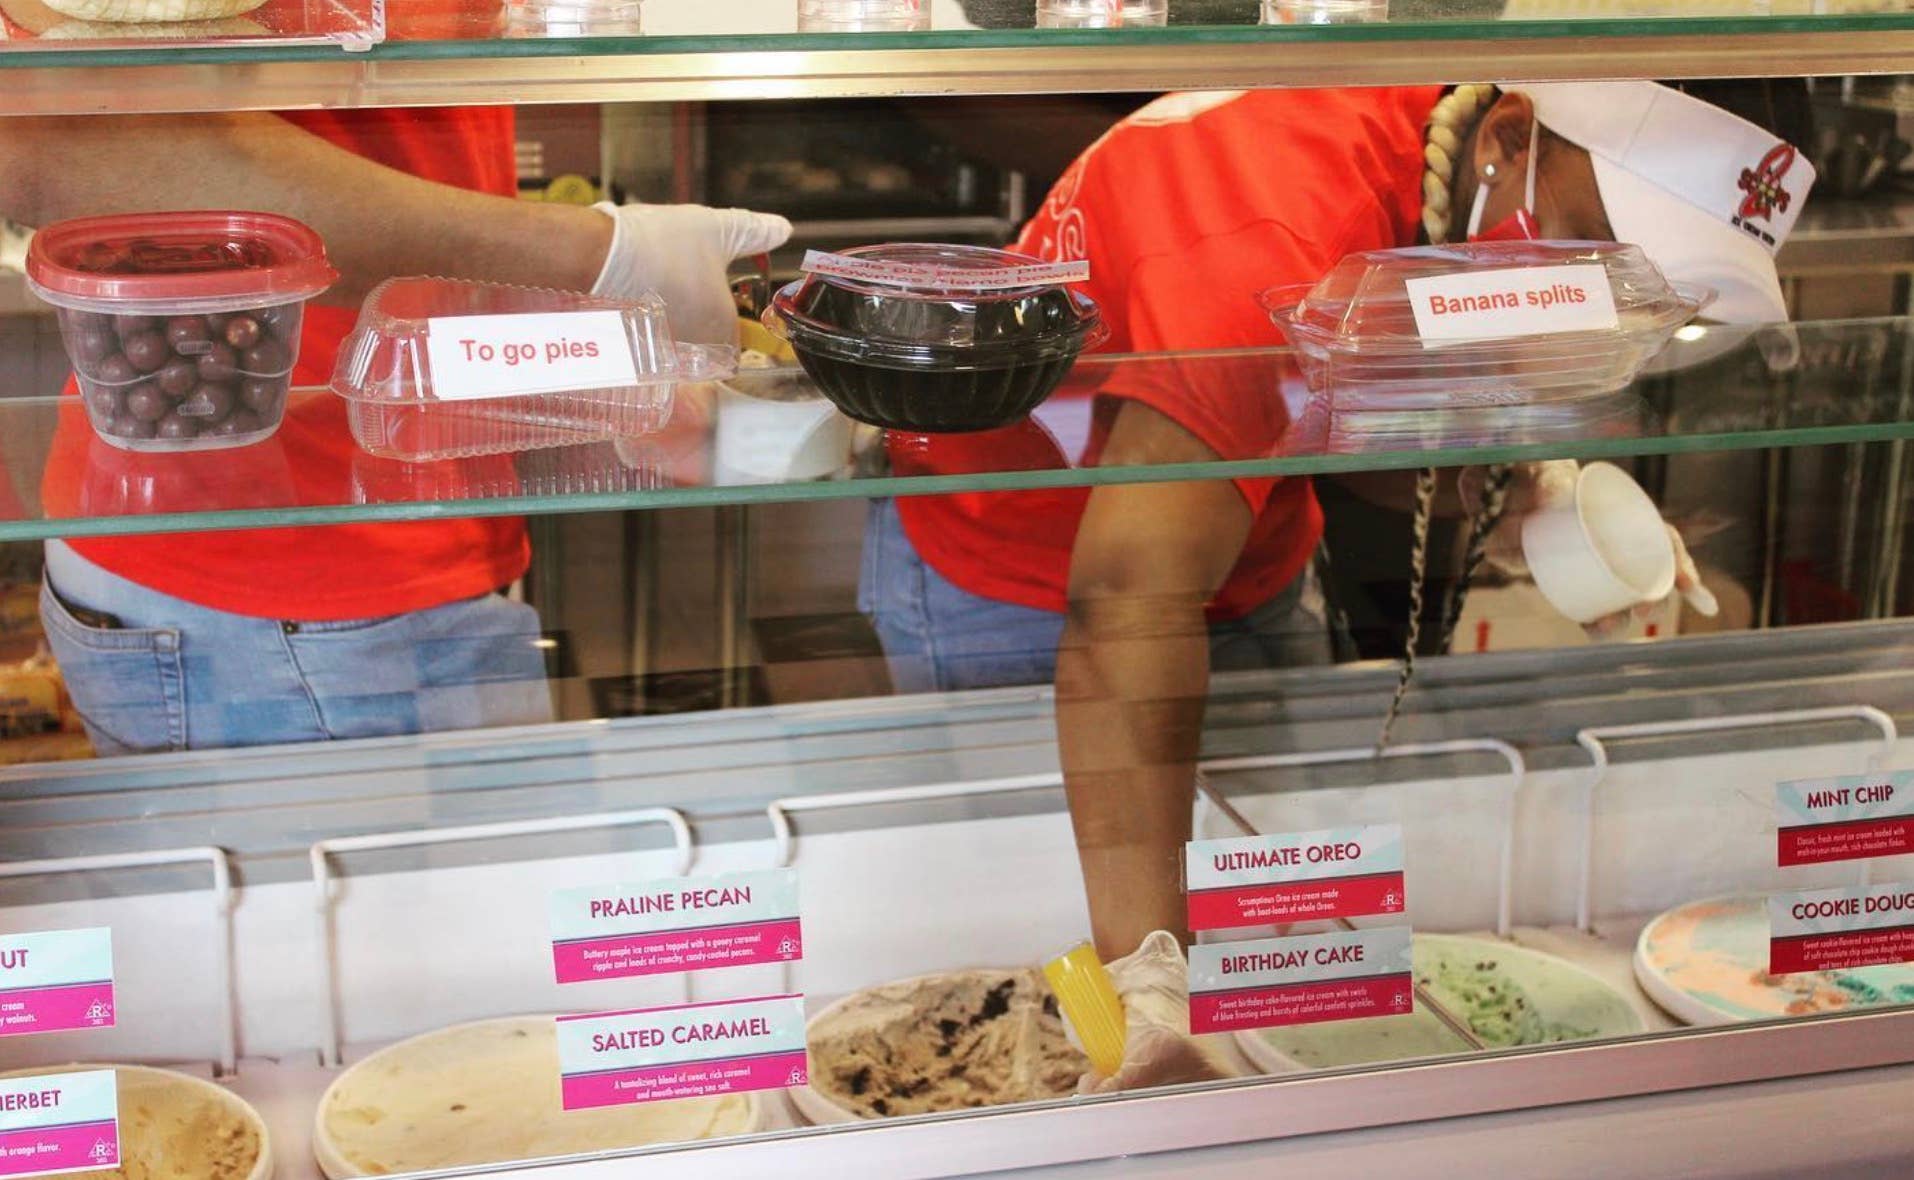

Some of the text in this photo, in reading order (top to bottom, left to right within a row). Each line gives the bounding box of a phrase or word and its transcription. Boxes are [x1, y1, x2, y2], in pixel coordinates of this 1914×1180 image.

[1429, 284, 1586, 315] Banana splits
[459, 337, 599, 366] To go pies
[1807, 785, 1894, 809] MINT CHIP
[1214, 842, 1361, 871] ULTIMATE OREO
[590, 886, 752, 919] PRALINE PECAN
[1301, 892, 1320, 900] cream
[1791, 898, 1859, 920] COOKIE
[583, 949, 609, 960] Buttery
[609, 945, 632, 957] maple
[632, 945, 642, 954] ice
[643, 944, 665, 953] cream
[665, 940, 689, 953] topped
[690, 937, 705, 949] with
[734, 932, 761, 944] caramel
[593, 960, 613, 972] ripple
[614, 958, 627, 968] and
[648, 955, 656, 965] of
[1221, 945, 1363, 974] BIRTHDAY CAKE
[592, 1017, 771, 1052] SALTED CARAMEL
[620, 1077, 656, 1089] tantalizing
[658, 1073, 677, 1084] blend
[678, 1072, 686, 1083] of
[709, 1070, 722, 1080] rich
[723, 1067, 751, 1078] caramel
[0, 1089, 61, 1111] ERBET
[636, 1089, 650, 1100] and
